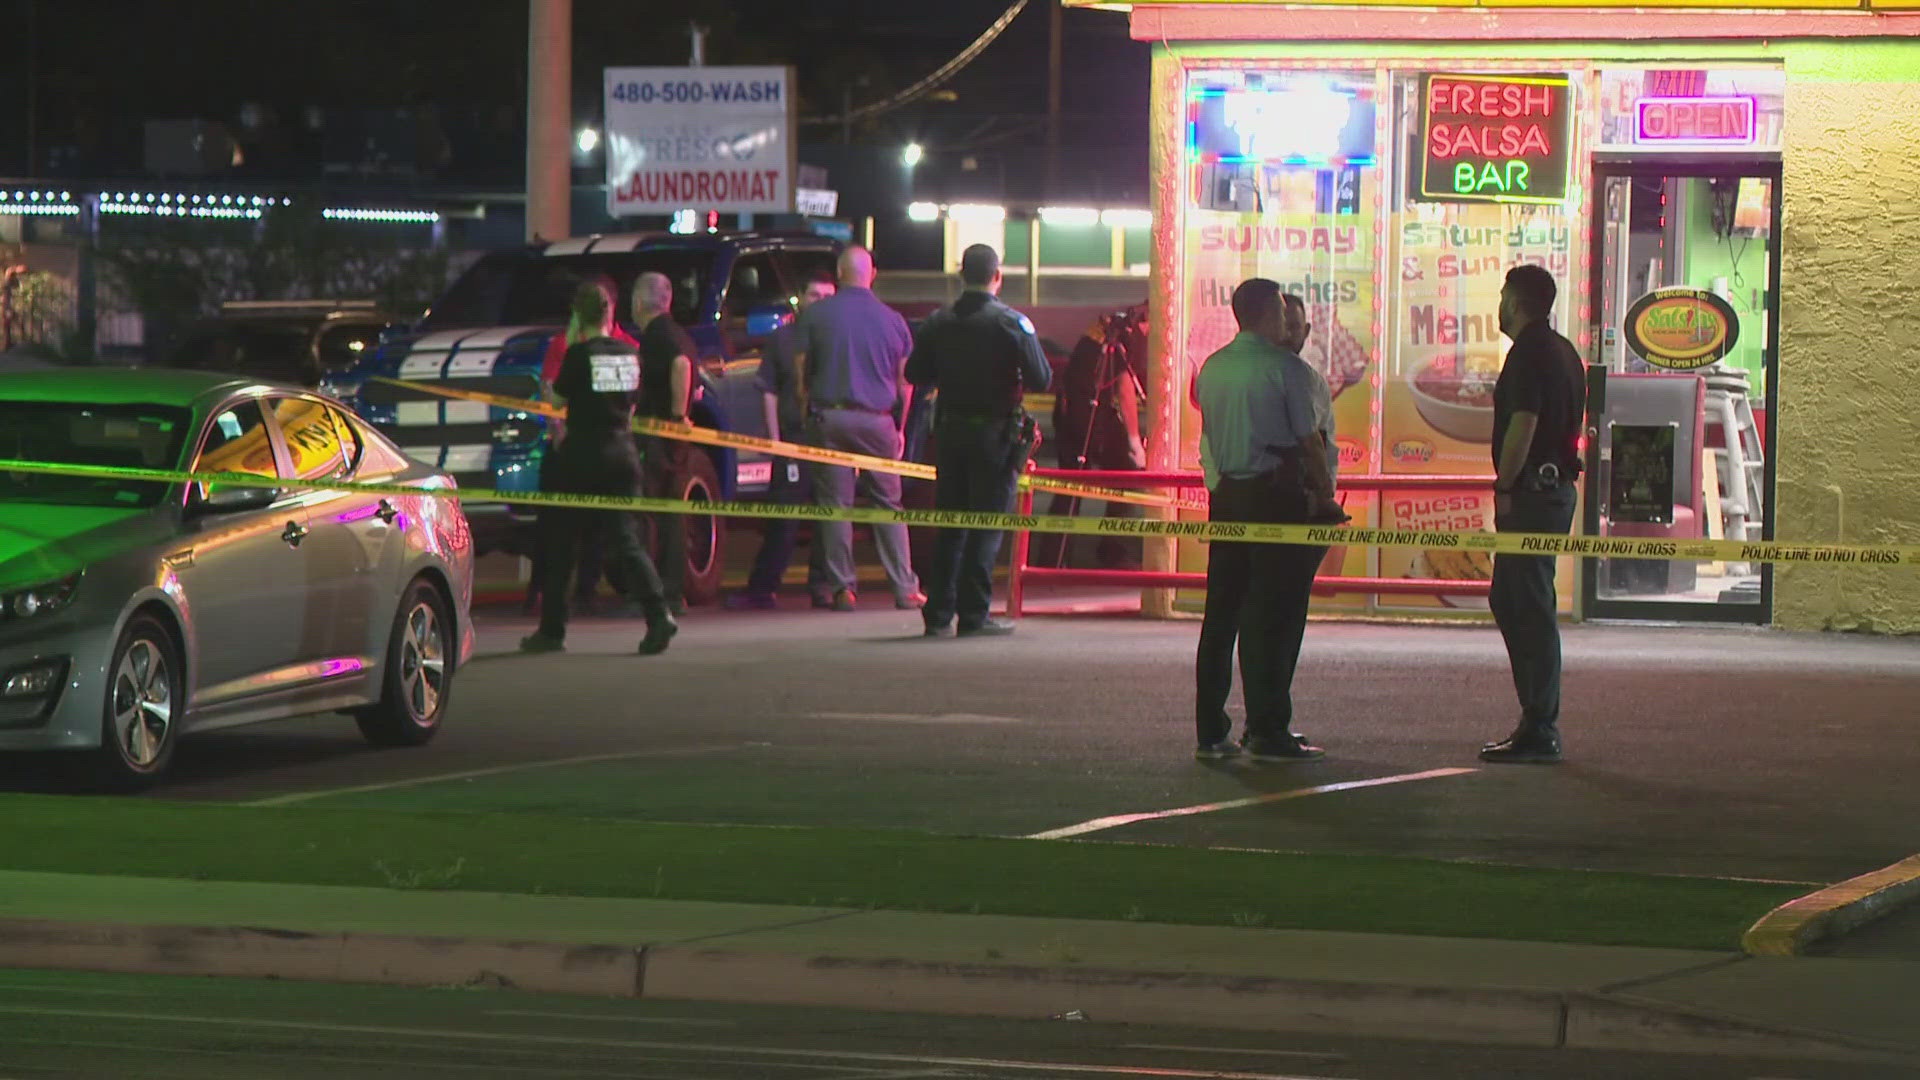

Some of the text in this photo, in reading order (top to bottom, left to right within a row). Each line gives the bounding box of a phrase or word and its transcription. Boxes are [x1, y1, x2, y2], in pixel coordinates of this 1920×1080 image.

[613, 81, 780, 102] 480-500-WASH
[1430, 84, 1551, 117] FRESH
[1643, 102, 1746, 137] OPEN
[1431, 124, 1550, 157] SALSA
[616, 170, 779, 203] LAUNDROMAT
[1454, 159, 1530, 193] BAR
[1201, 225, 1356, 254] SUNDAY
[1403, 222, 1569, 251] Saturday
[1402, 256, 1425, 281] &
[1200, 273, 1357, 307] Huches
[1655, 289, 1694, 300] Welcome
[1410, 304, 1558, 345] Menu
[1672, 358, 1690, 368] OPEN
[893, 511, 929, 522] POLICE
[933, 512, 959, 524] LINE
[960, 513, 976, 525] DO
[977, 514, 999, 526] NOT
[1002, 515, 1039, 528] CROSS
[1394, 495, 1480, 519] Quesa
[1098, 519, 1137, 531] POLICE
[1139, 520, 1164, 533] LINE
[1166, 522, 1184, 534] DO
[1185, 523, 1206, 535] NOT
[1208, 524, 1248, 537] CROSS
[1307, 529, 1347, 541] POLICE
[1349, 530, 1375, 543] LINE
[1377, 531, 1395, 544] DO
[1396, 532, 1419, 545] NOT
[1420, 533, 1460, 546] CROSS
[1521, 538, 1562, 551] POLICE
[1563, 539, 1590, 553] LINE
[1592, 540, 1610, 553] DO
[1611, 541, 1635, 555] NOT
[1637, 542, 1677, 556] CROSS
[1741, 546, 1782, 560] POLICE
[1784, 547, 1811, 561] LINE
[1814, 548, 1832, 562] DO
[1833, 549, 1857, 563] NOT
[1860, 550, 1901, 564] CROSS
